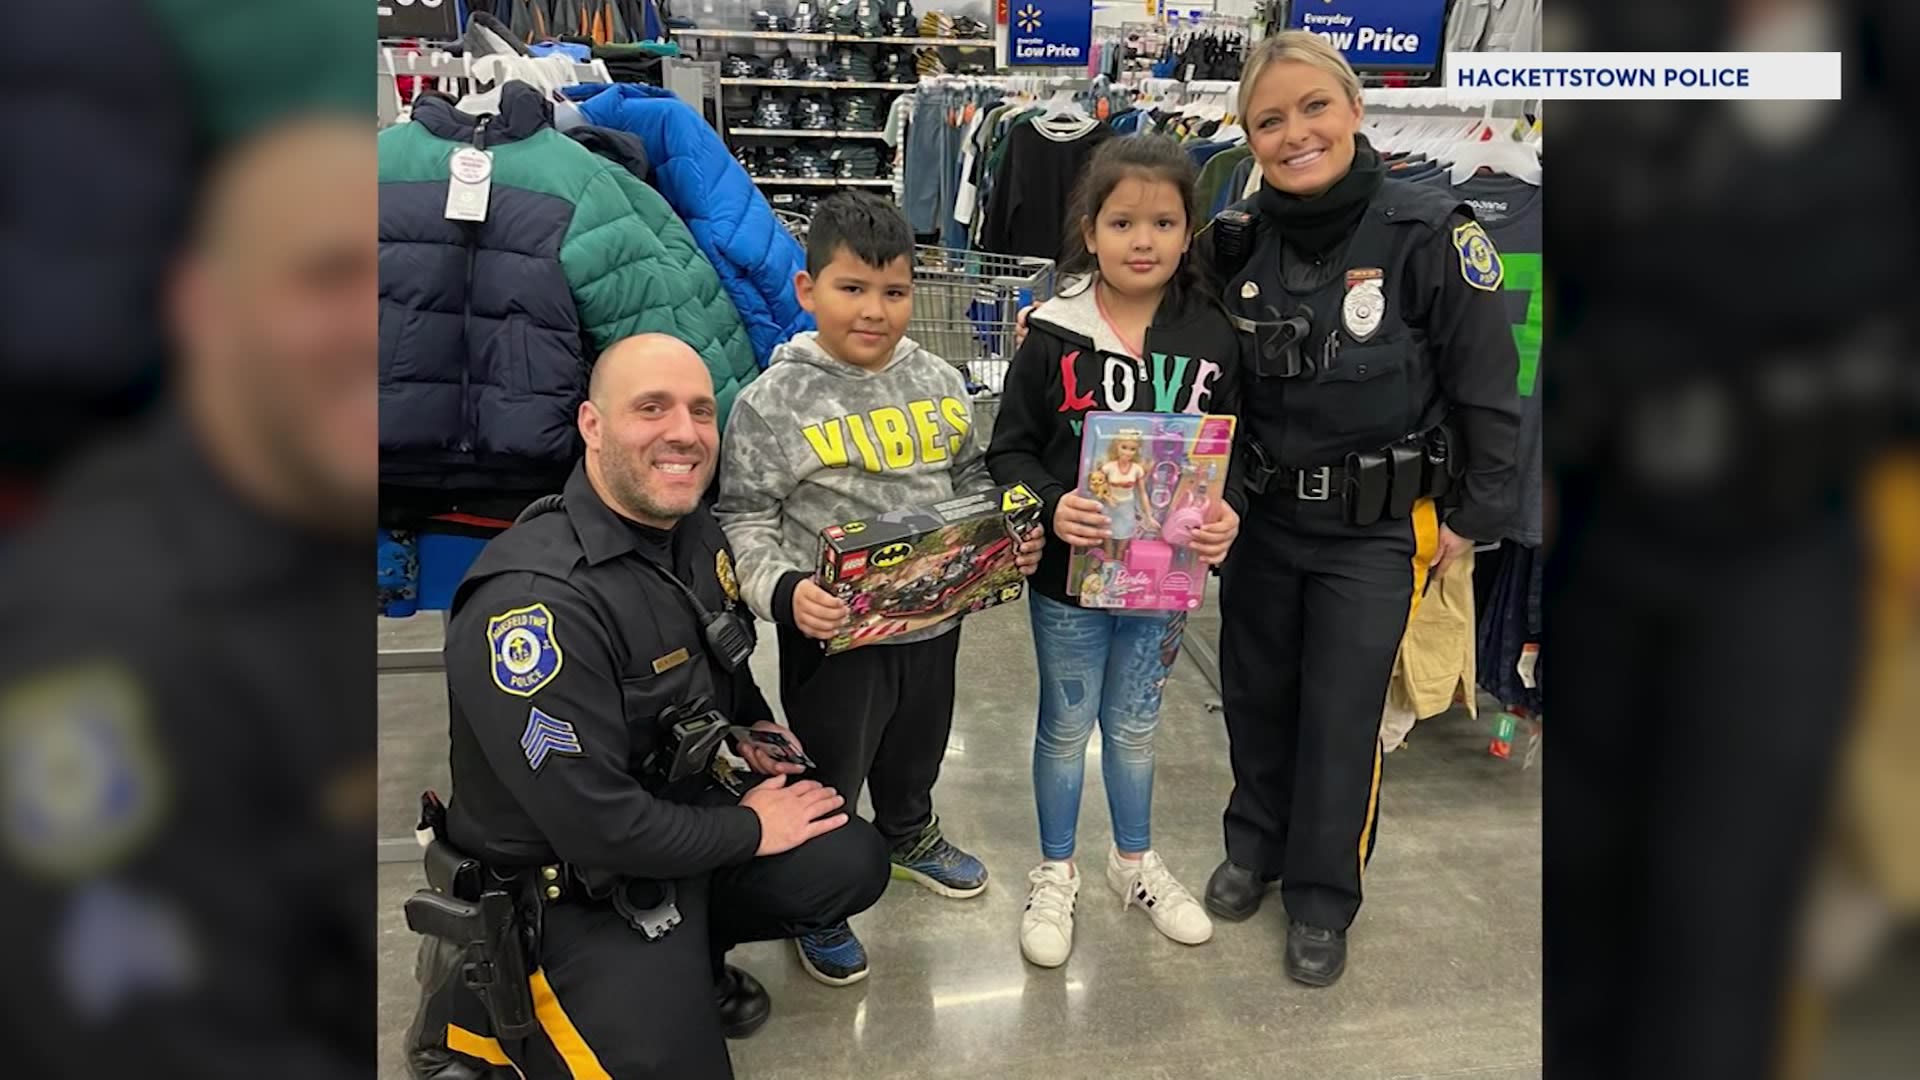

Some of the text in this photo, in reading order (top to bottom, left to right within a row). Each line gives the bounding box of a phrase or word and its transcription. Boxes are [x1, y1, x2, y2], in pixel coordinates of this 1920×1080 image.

[1303, 13, 1353, 26] Everyday
[1303, 26, 1419, 52] ow Price
[1016, 44, 1081, 58] Low Price
[1057, 351, 1224, 414] LOVE
[801, 396, 970, 473] VIBES
[1114, 569, 1152, 586] Barbie
[510, 668, 544, 688] POLICE
